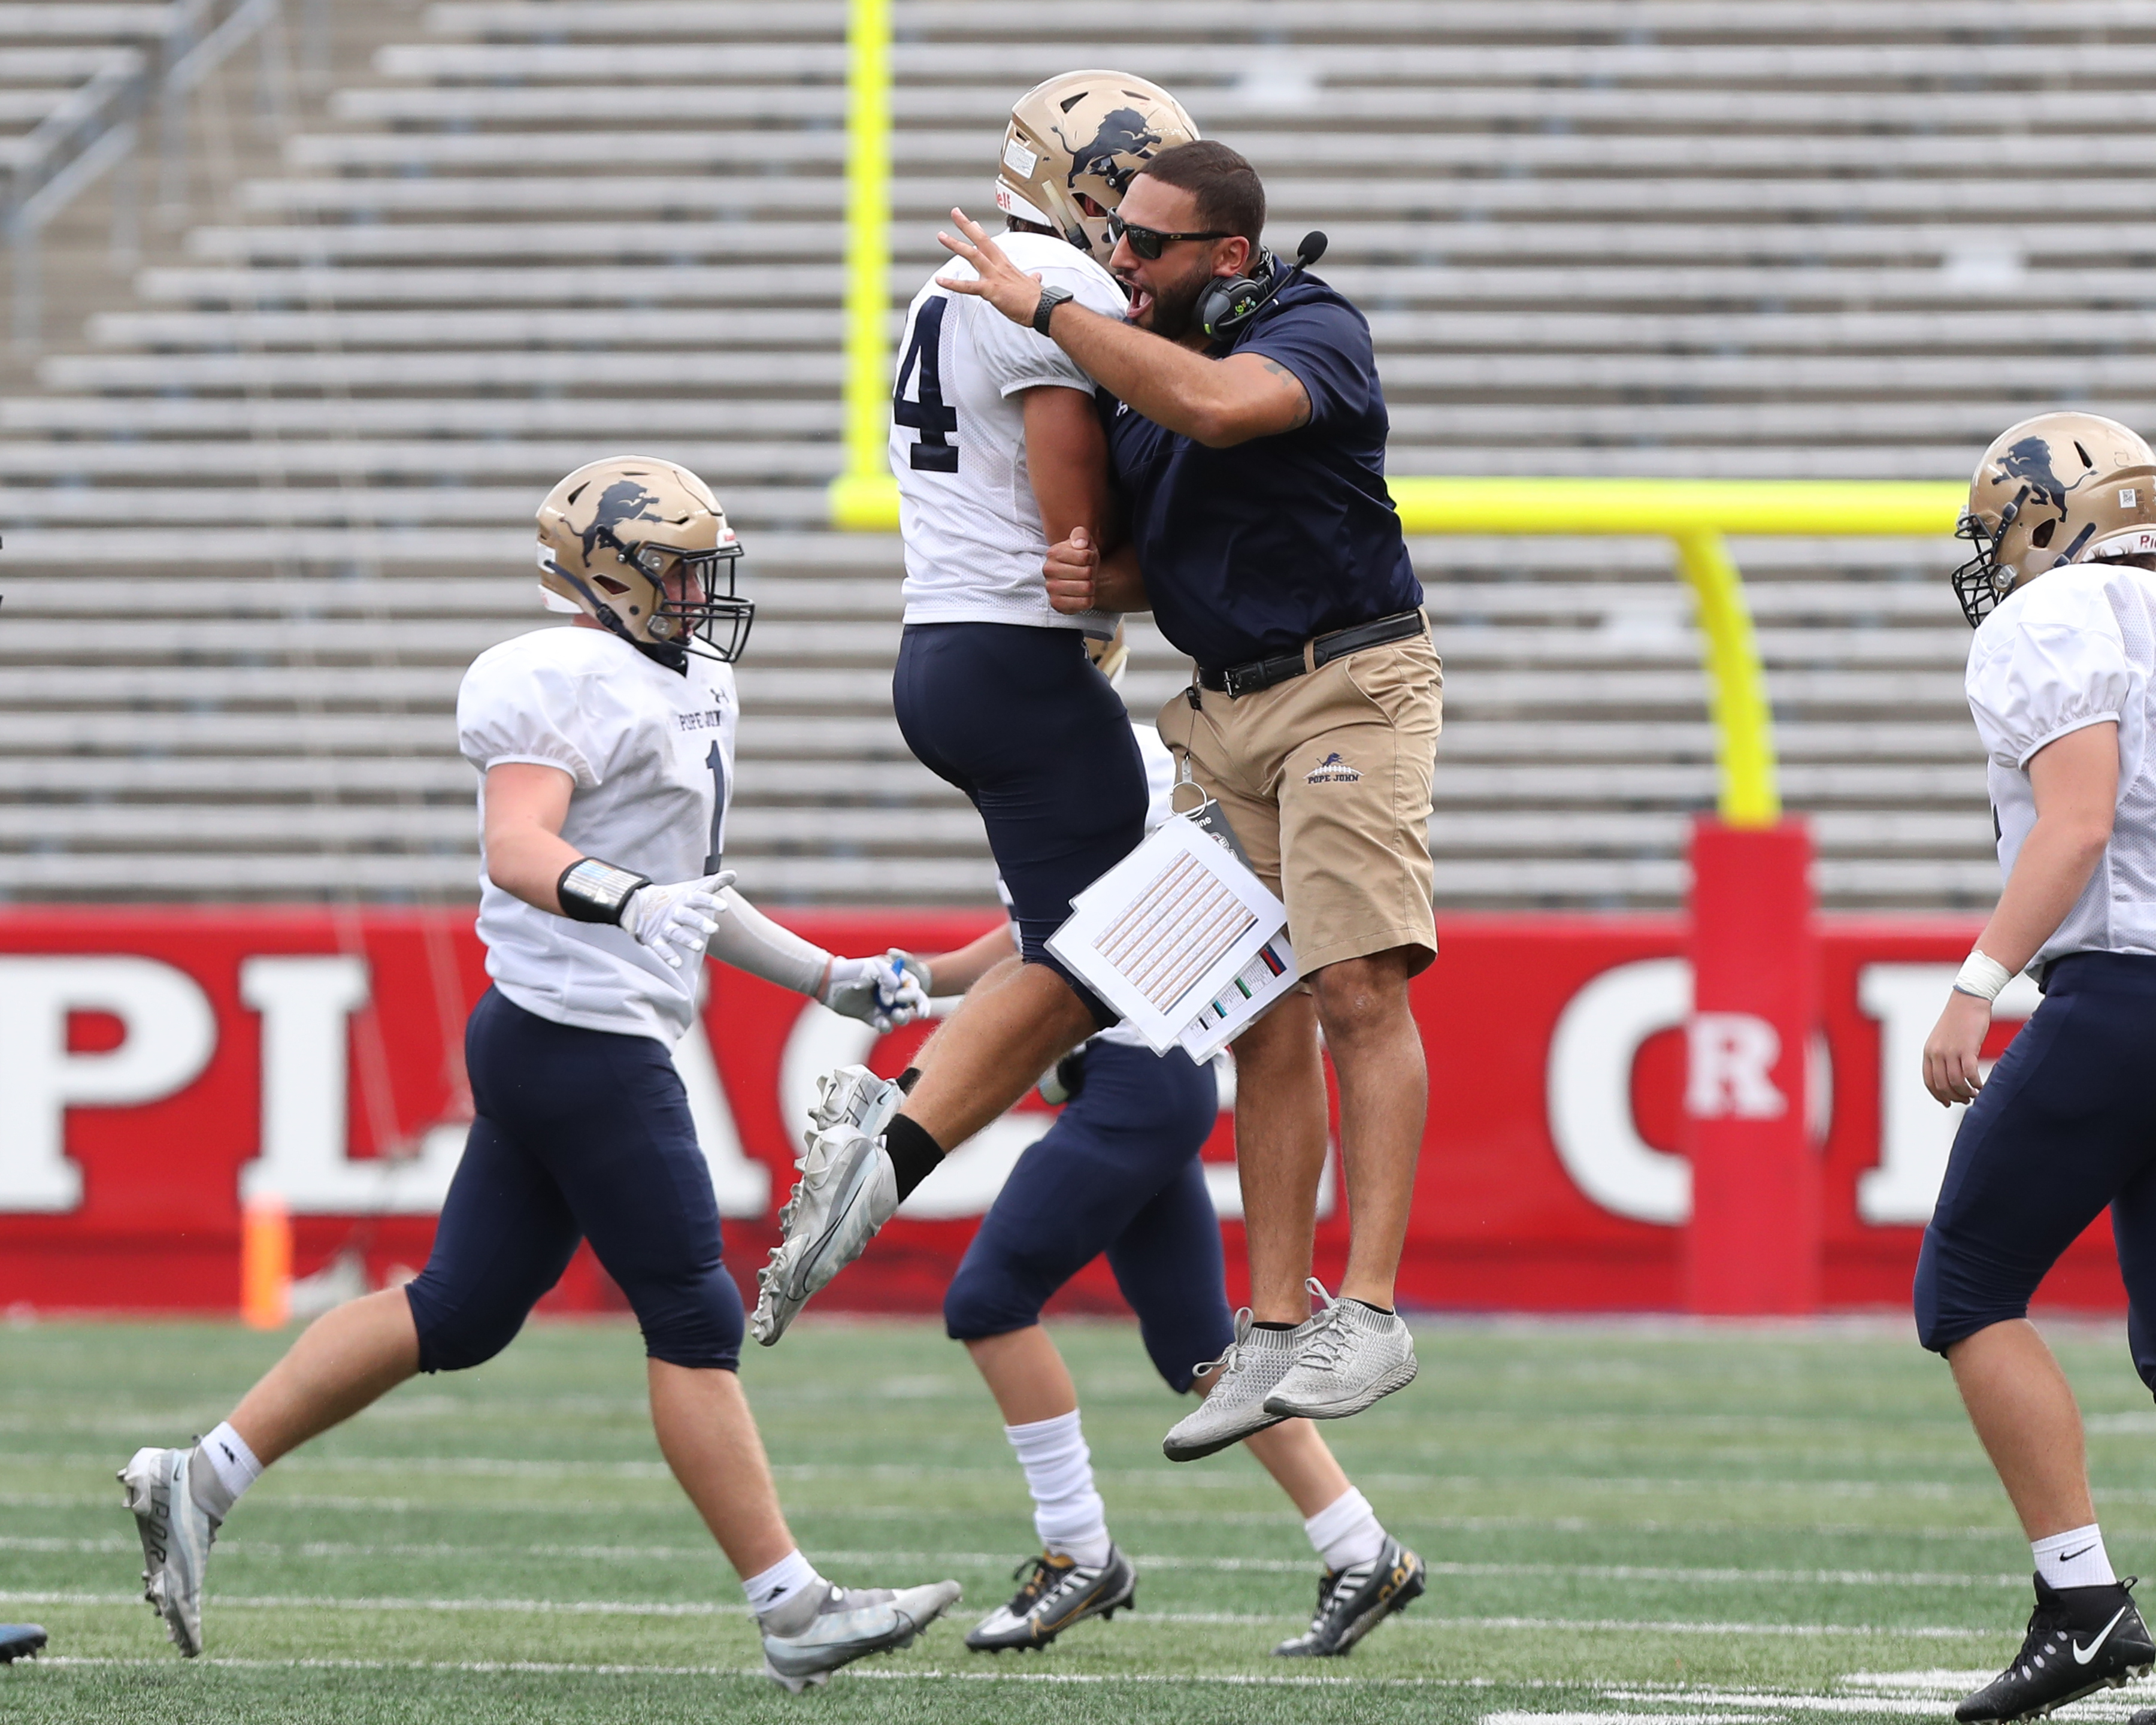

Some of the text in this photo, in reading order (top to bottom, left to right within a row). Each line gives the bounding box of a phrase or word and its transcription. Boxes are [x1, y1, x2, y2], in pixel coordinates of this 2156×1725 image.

[894, 295, 958, 473] 4
[2140, 535, 2156, 548] Ri
[704, 739, 725, 876] 1
[1308, 775, 1330, 784] POPE
[1683, 1011, 1789, 1119] R
